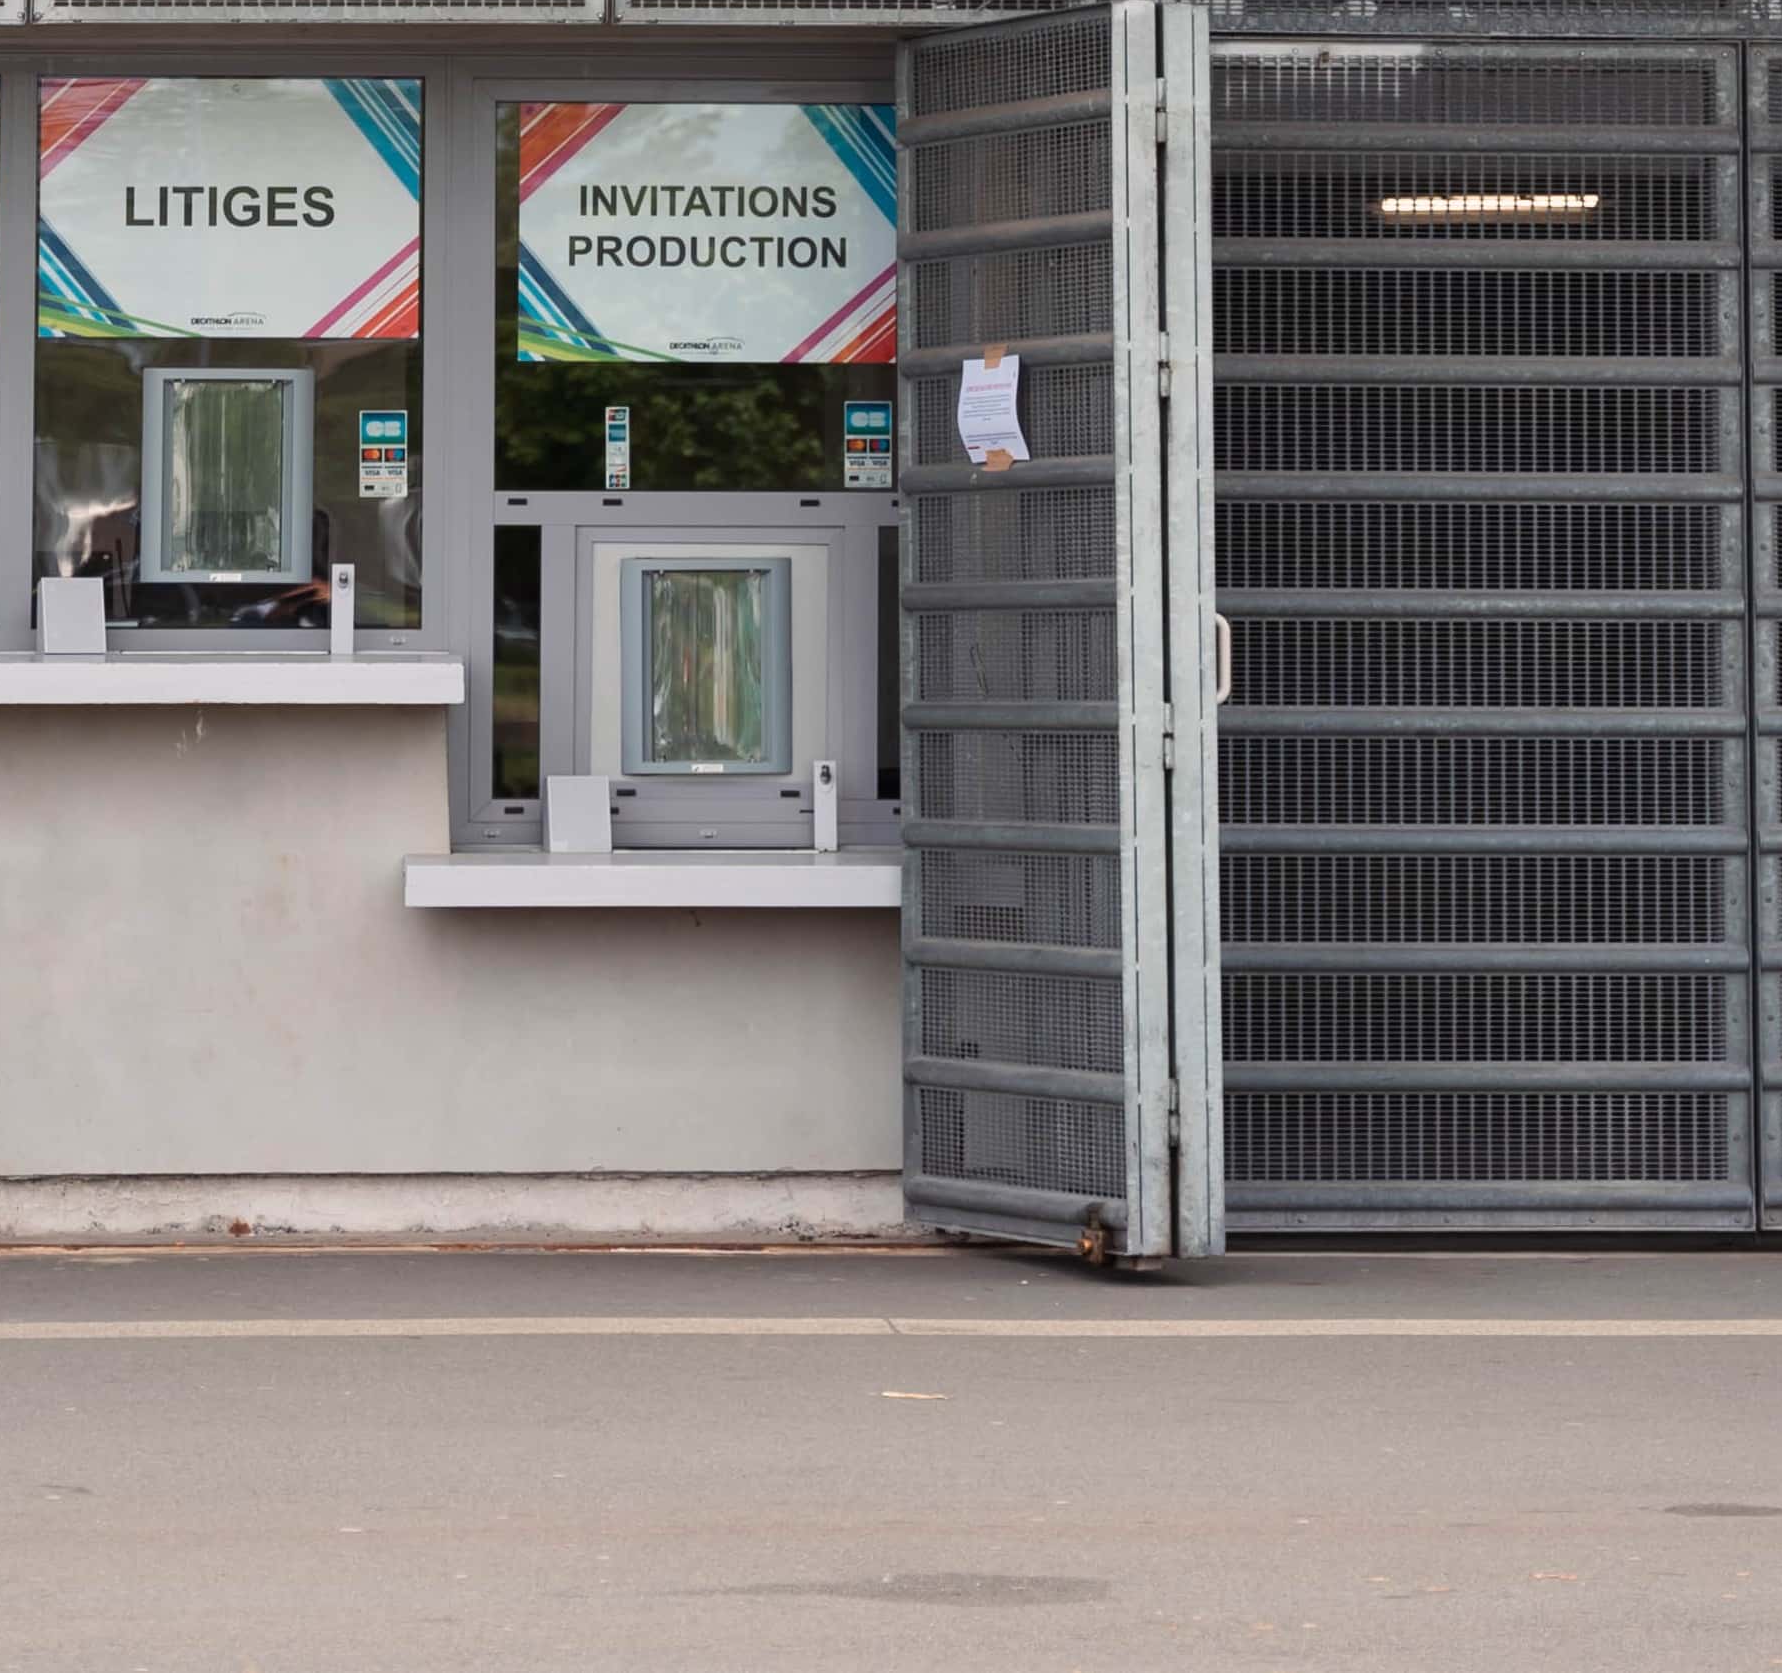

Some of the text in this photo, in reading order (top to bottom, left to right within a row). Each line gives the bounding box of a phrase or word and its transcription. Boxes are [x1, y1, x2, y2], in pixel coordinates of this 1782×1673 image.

[125, 185, 336, 228] LITIGES
[579, 184, 838, 219] INVITATIONS
[567, 234, 848, 269] PRODUCTION
